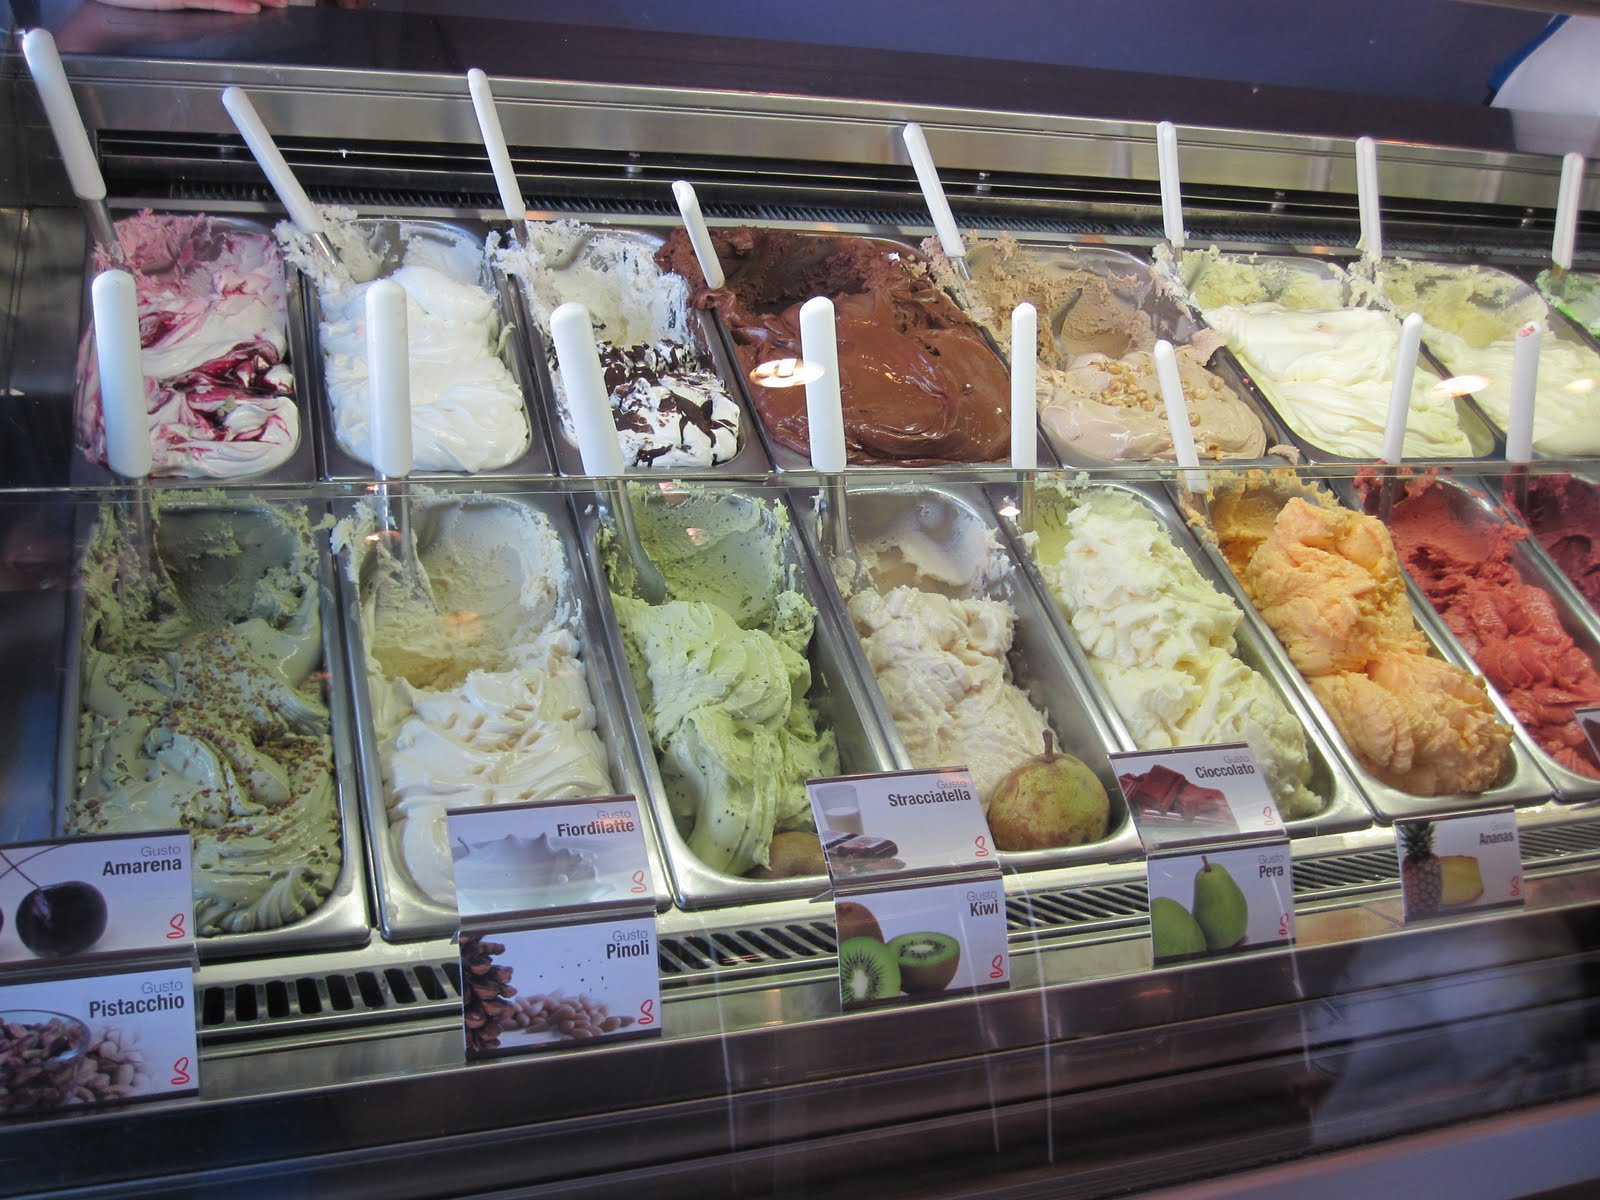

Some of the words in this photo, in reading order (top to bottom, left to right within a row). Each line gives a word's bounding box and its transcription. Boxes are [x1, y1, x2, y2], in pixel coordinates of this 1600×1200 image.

[1195, 763, 1255, 779] Cioccolato
[936, 780, 967, 789] Gusto
[887, 788, 971, 807] Stracciatella
[597, 810, 631, 820] Gusto
[557, 820, 635, 837] Fiordilatte
[1479, 832, 1514, 845] Ananas
[141, 845, 181, 857] Gusto
[102, 858, 182, 876] Amarena
[1259, 866, 1283, 878] Pera
[967, 891, 997, 901] Gusto
[970, 901, 999, 916] Kiwi
[612, 930, 648, 942] Gusto
[606, 940, 649, 959] Pinoli
[141, 982, 183, 994] Gusto
[89, 994, 185, 1018] Pistacchio
